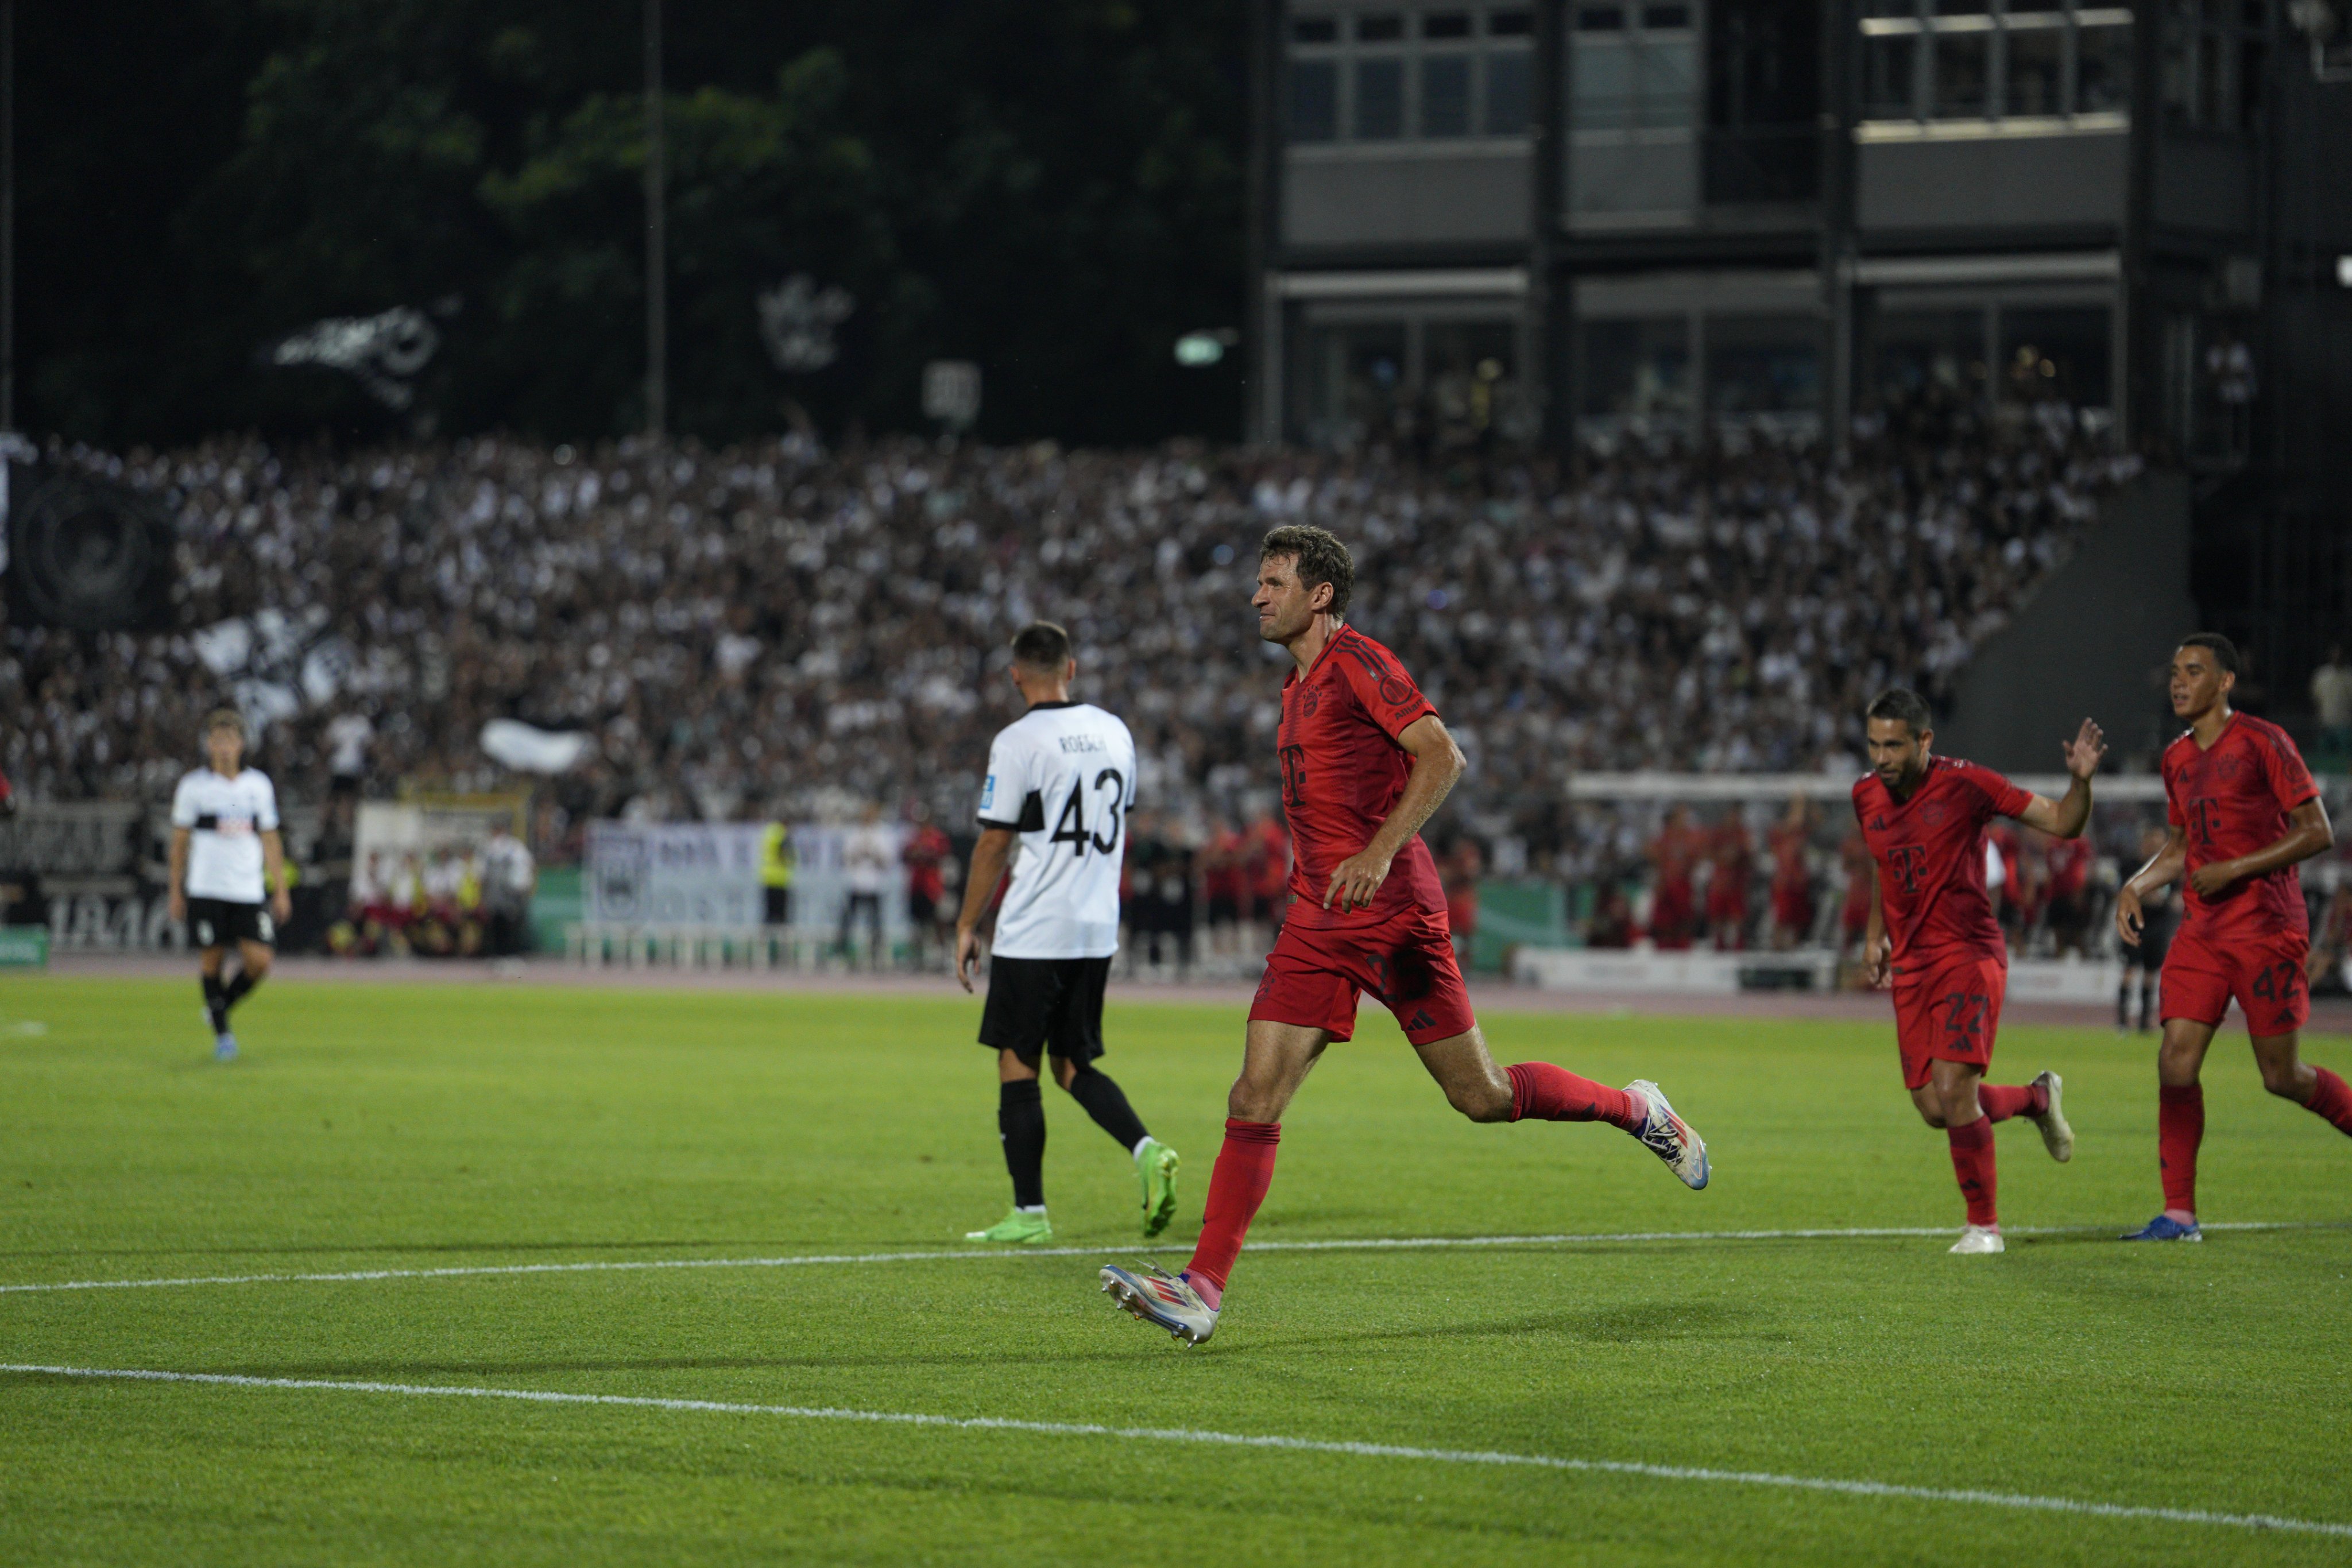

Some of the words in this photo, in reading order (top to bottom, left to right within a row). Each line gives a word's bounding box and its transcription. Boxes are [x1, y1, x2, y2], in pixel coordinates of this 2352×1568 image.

[1049, 768, 1124, 856] 43
[1366, 949, 1430, 1002] 25
[2253, 961, 2300, 1003] 42
[1945, 993, 1989, 1033] 22
